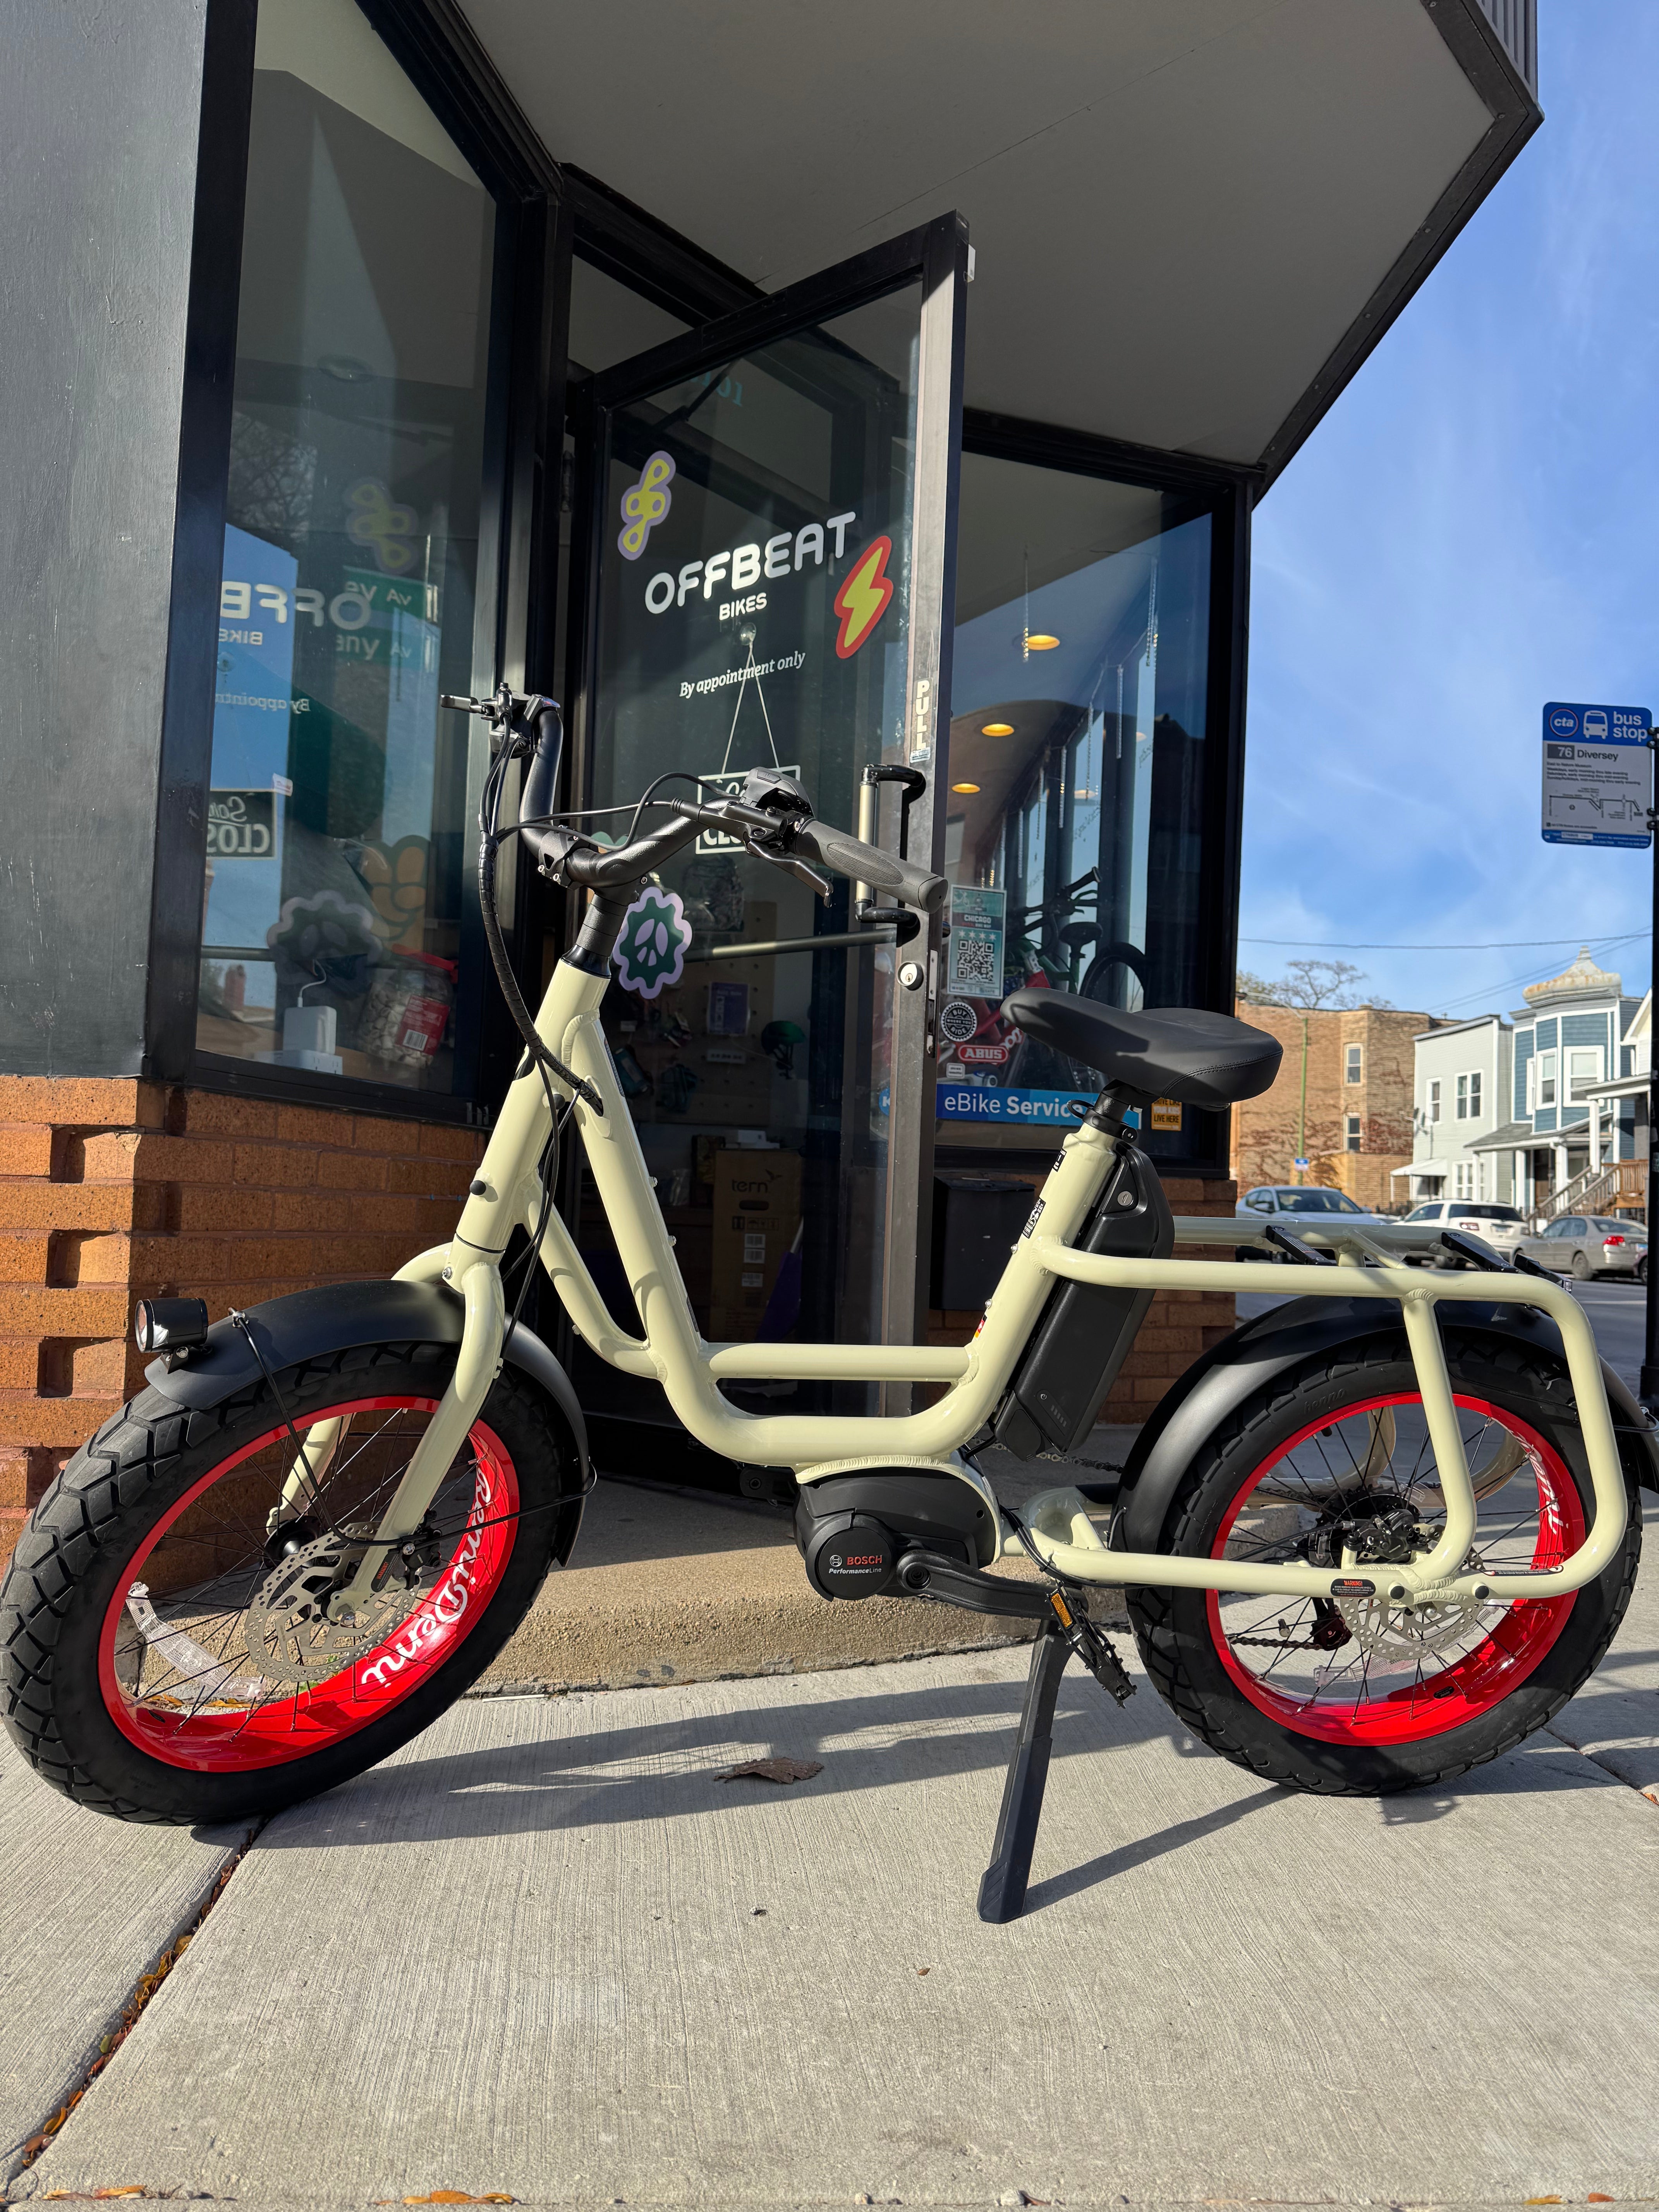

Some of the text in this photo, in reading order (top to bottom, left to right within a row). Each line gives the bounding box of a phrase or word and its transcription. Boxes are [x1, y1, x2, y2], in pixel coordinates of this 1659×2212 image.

[645, 511, 856, 614] OFFBEAT
[719, 592, 767, 621] BIKES
[679, 651, 806, 698] By appointment only
[916, 680, 930, 750] PULL
[1554, 717, 1574, 727] cta
[1613, 711, 1642, 726] bus
[1613, 727, 1648, 742] stop
[1557, 746, 1619, 763] 76 Diversey
[963, 914, 992, 924] CHICAGO
[952, 1008, 967, 1017] BUY
[950, 1025, 967, 1036] RIDE
[964, 1048, 1003, 1059] ABUS
[944, 1092, 1001, 1113] eBike
[1166, 1115, 1179, 1123] HERE
[732, 1178, 769, 1193] tern
[846, 1554, 883, 1566] BOSCH
